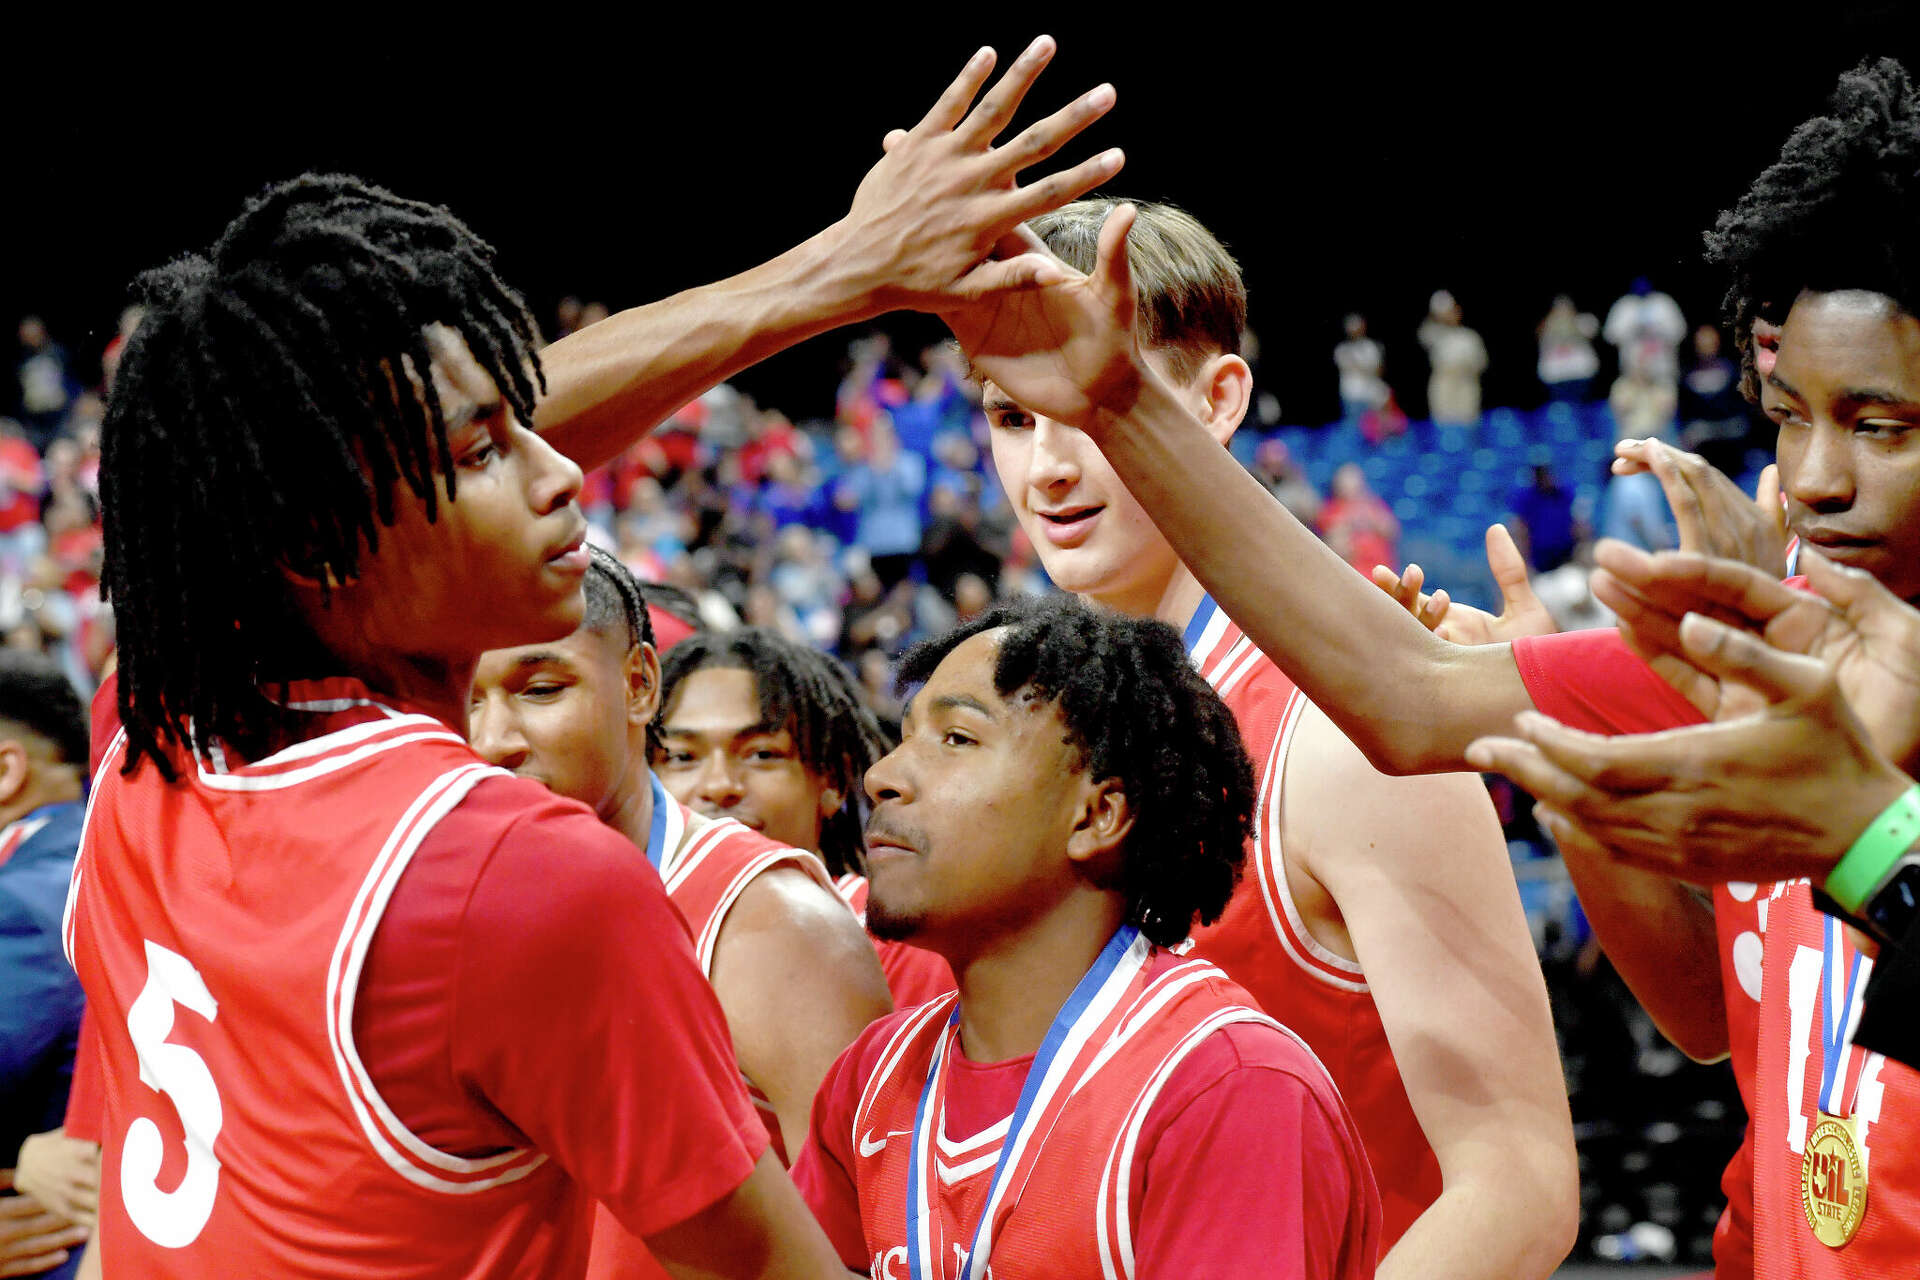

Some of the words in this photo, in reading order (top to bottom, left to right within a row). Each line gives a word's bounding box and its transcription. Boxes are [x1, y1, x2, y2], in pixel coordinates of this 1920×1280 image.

[120, 938, 223, 1249] 5
[1812, 1151, 1849, 1207] UIL
[1817, 1201, 1842, 1221] STATE
